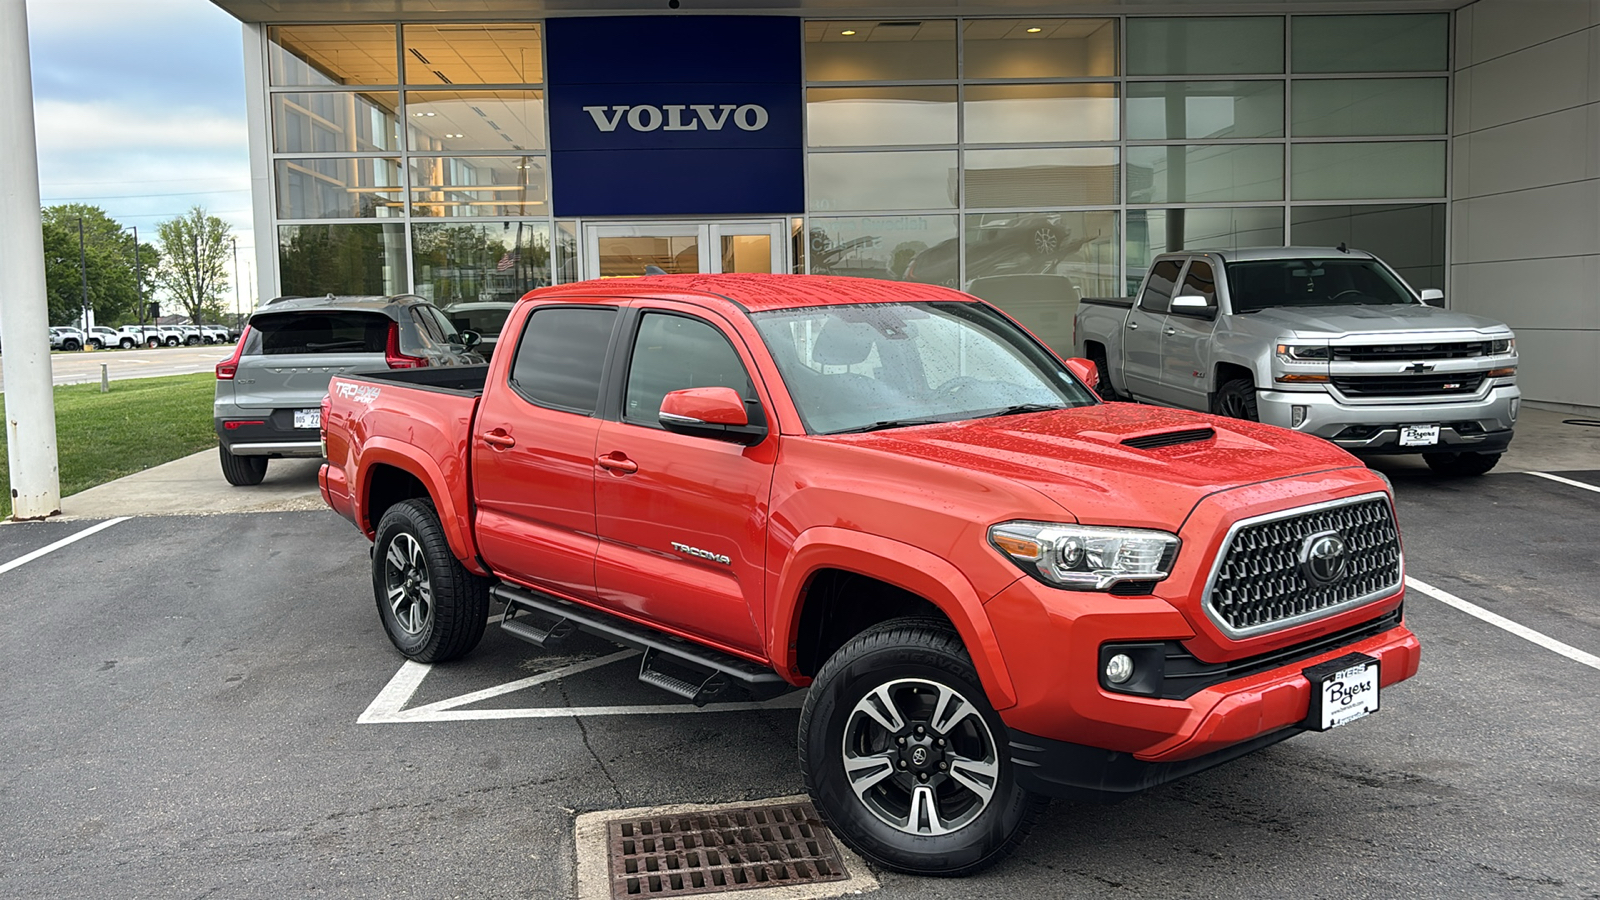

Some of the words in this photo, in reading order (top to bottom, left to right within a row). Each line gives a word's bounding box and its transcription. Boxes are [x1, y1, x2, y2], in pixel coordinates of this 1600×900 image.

[582, 104, 769, 132] VOLVO
[862, 216, 928, 231] Swedish
[670, 541, 731, 566] TACOMA
[1325, 681, 1371, 705] Byers
